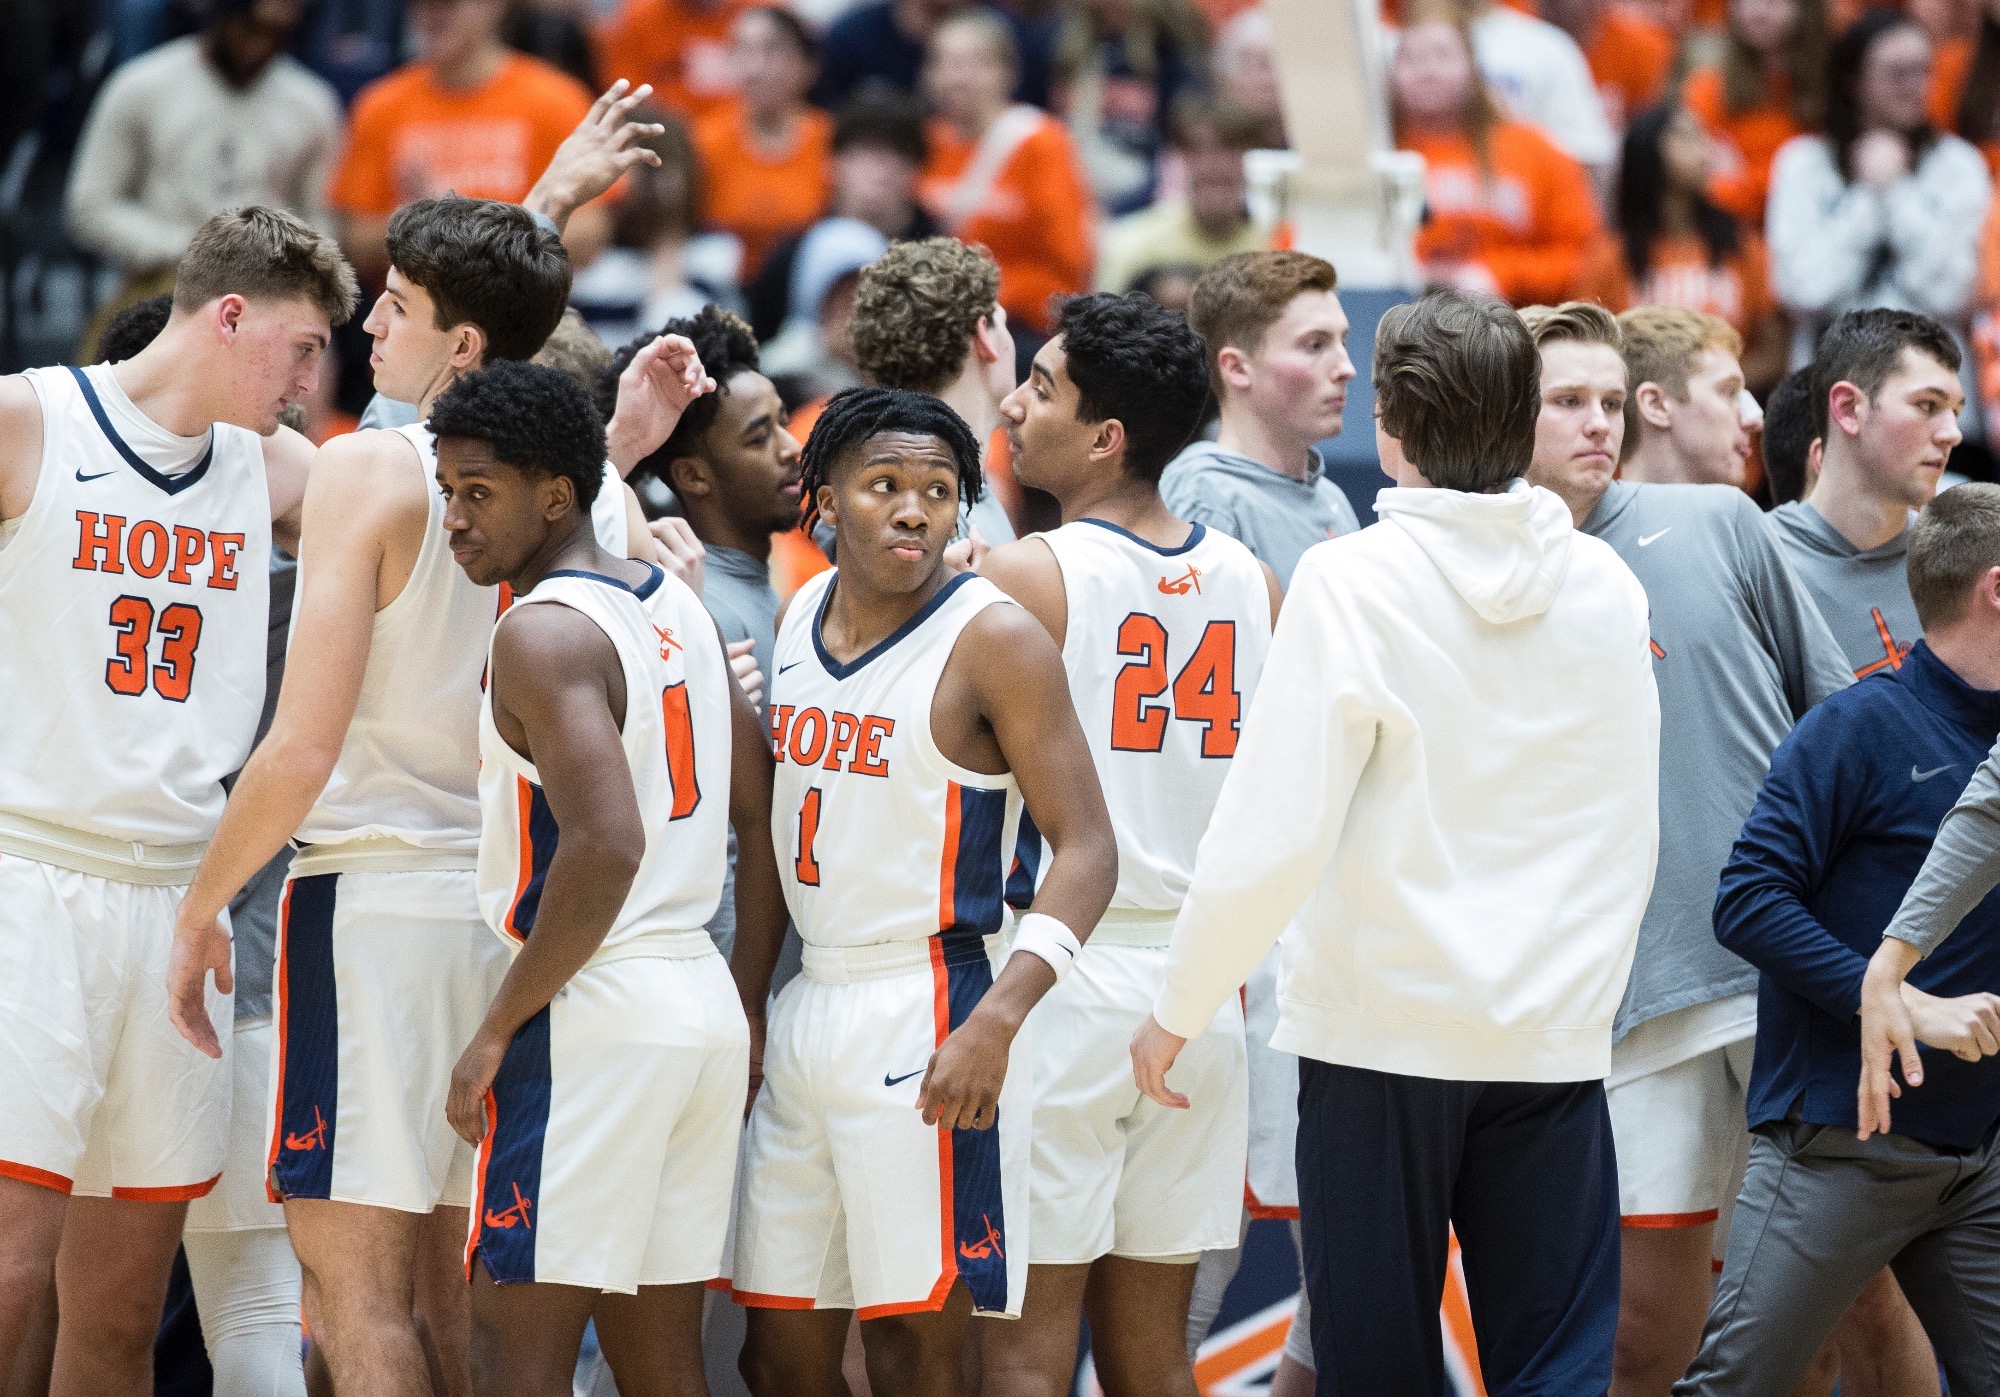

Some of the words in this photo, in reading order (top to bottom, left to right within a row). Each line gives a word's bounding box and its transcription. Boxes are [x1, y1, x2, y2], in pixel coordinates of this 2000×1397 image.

[72, 509, 246, 591] HOPE
[105, 594, 203, 703] 33
[1111, 611, 1241, 759] 24
[770, 704, 896, 778] HOPE
[795, 786, 822, 888] 1
